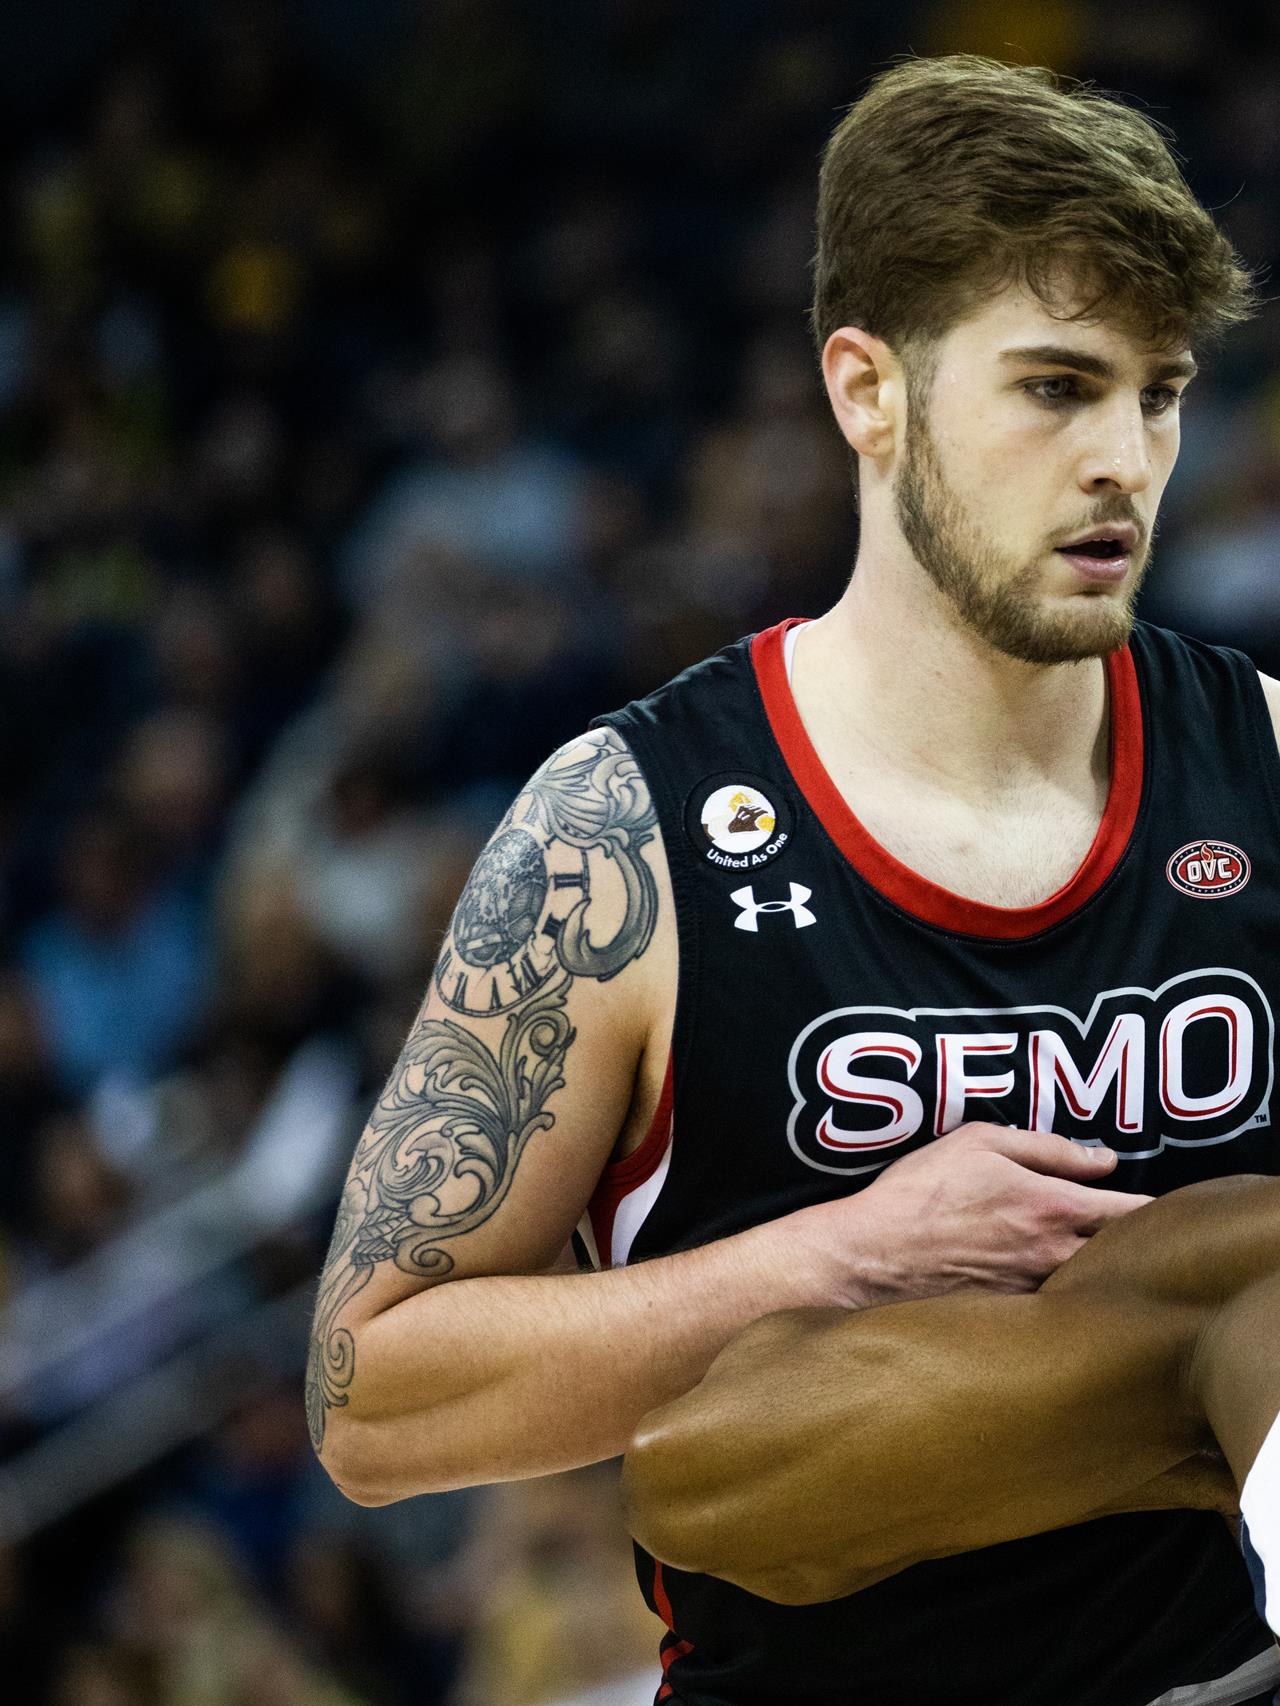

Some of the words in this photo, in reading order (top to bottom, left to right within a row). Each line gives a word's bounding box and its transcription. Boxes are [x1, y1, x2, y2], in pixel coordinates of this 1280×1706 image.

[706, 848, 749, 868] United
[752, 853, 768, 866] As
[765, 832, 788, 855] One
[1186, 857, 1233, 883] OVC
[815, 993, 1254, 1152] SEMO
[1254, 1114, 1267, 1123] TM
